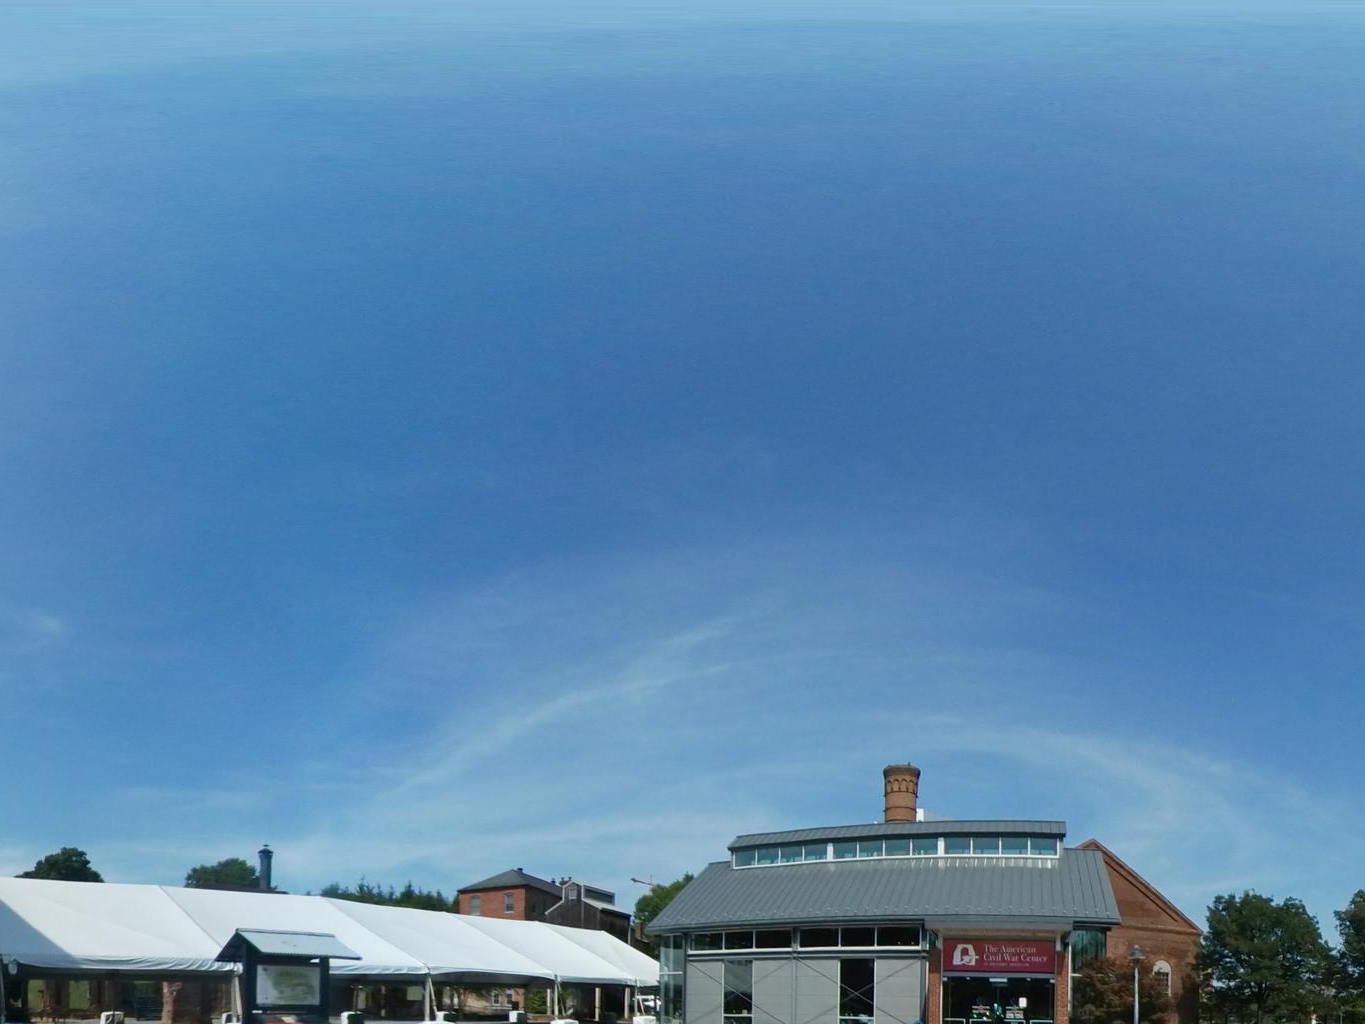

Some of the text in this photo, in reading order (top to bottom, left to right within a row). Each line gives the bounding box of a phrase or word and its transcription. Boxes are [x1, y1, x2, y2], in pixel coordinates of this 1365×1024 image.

[984, 944, 1036, 953] The American
[983, 953, 1048, 963] Civil War Center
